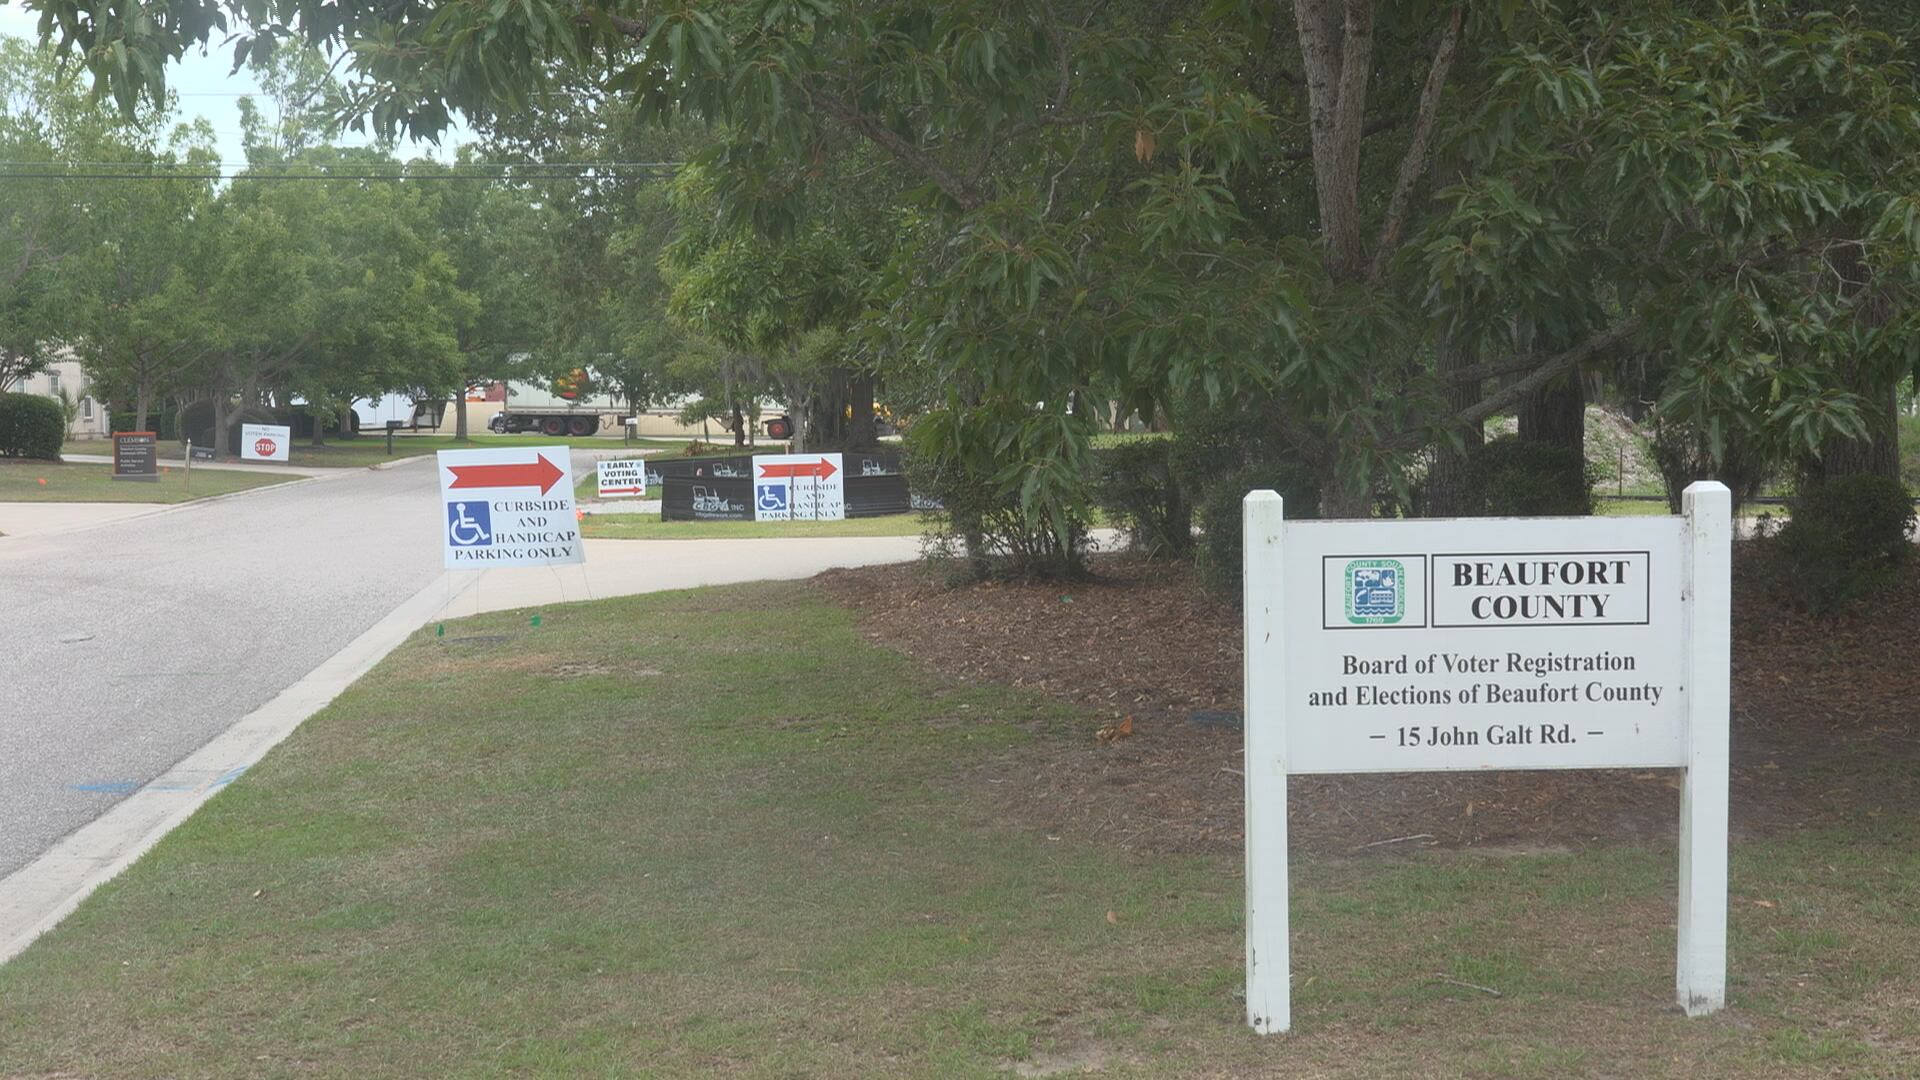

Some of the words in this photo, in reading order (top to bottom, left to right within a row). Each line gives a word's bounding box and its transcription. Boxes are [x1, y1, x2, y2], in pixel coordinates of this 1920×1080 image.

[256, 443, 275, 452] STOP
[601, 478, 641, 486] CENTER
[494, 499, 569, 512] CURBSIDE
[761, 511, 807, 519] PARKNG
[517, 516, 547, 528] AND
[495, 531, 576, 544] HANDICAP
[455, 548, 523, 560] PARKING
[527, 546, 573, 559] ONLY
[1453, 561, 1630, 586] BEAUFORT
[1472, 594, 1610, 619] COUNTY
[1344, 655, 1407, 674] Board
[1415, 654, 1437, 673] of
[1442, 654, 1499, 673] Voter
[1507, 651, 1635, 677] Registration
[1309, 687, 1347, 706] and
[1356, 685, 1451, 705] Elections
[1459, 684, 1480, 704] of
[1487, 683, 1578, 703] Beaufort
[1586, 682, 1662, 706] County
[1399, 727, 1420, 746] 15
[1427, 726, 1478, 746] John
[1487, 725, 1532, 745] Galt
[1541, 724, 1576, 744] Rd.
